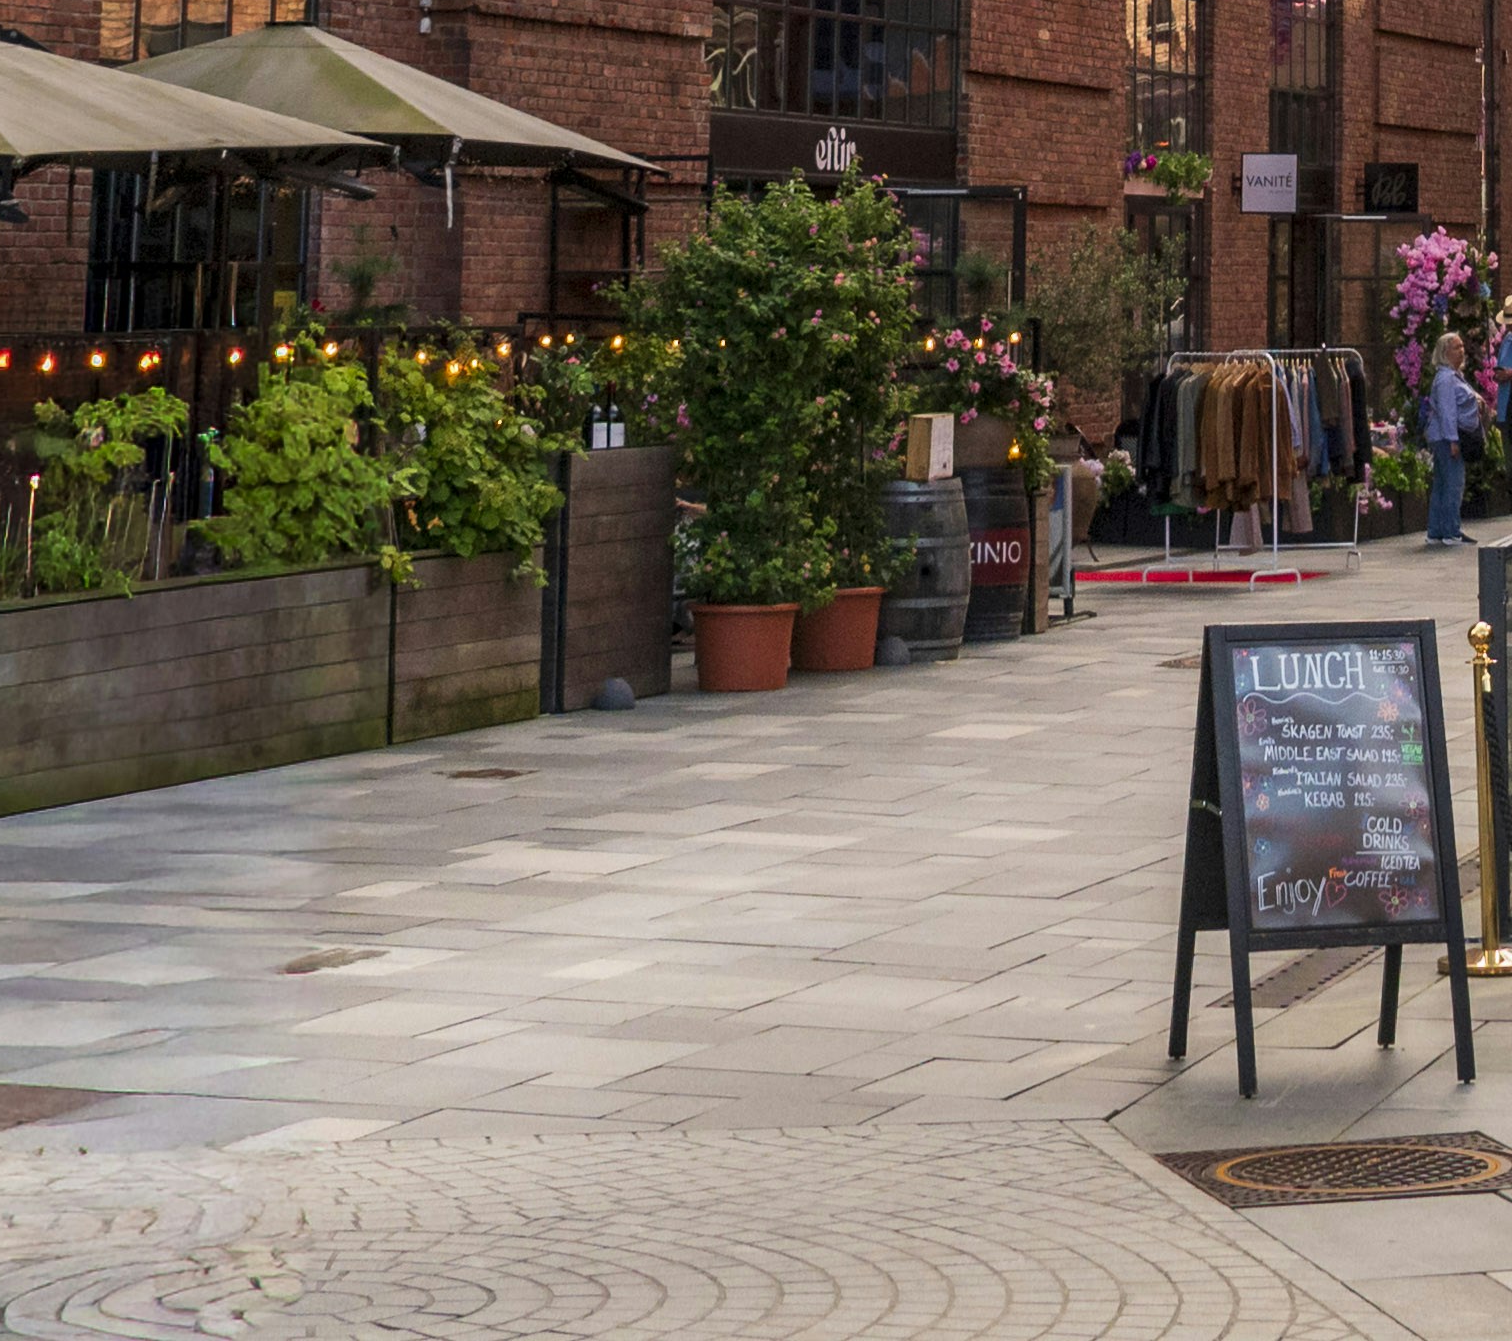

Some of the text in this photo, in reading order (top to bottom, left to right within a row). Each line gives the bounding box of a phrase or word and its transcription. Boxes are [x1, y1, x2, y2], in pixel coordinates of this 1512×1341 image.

[1246, 172, 1292, 188] VANITÉ
[1250, 651, 1365, 691] LUNCH
[1281, 724, 1333, 740] SKAGEN
[1336, 724, 1366, 739] TOAST
[1263, 746, 1314, 761] MIDDLE
[1316, 746, 1346, 761] EAST
[1346, 748, 1379, 763] SALAD
[1296, 771, 1342, 786] ITALIAN
[1347, 772, 1382, 787] SALAD
[1304, 792, 1345, 808] KEBAB
[1366, 816, 1402, 834] COLD
[1362, 833, 1409, 851] DRINKS
[1380, 855, 1402, 870] ICED
[1403, 855, 1420, 870] TEA
[1344, 870, 1392, 888] COFFEE
[1257, 867, 1326, 917] Enjoy
